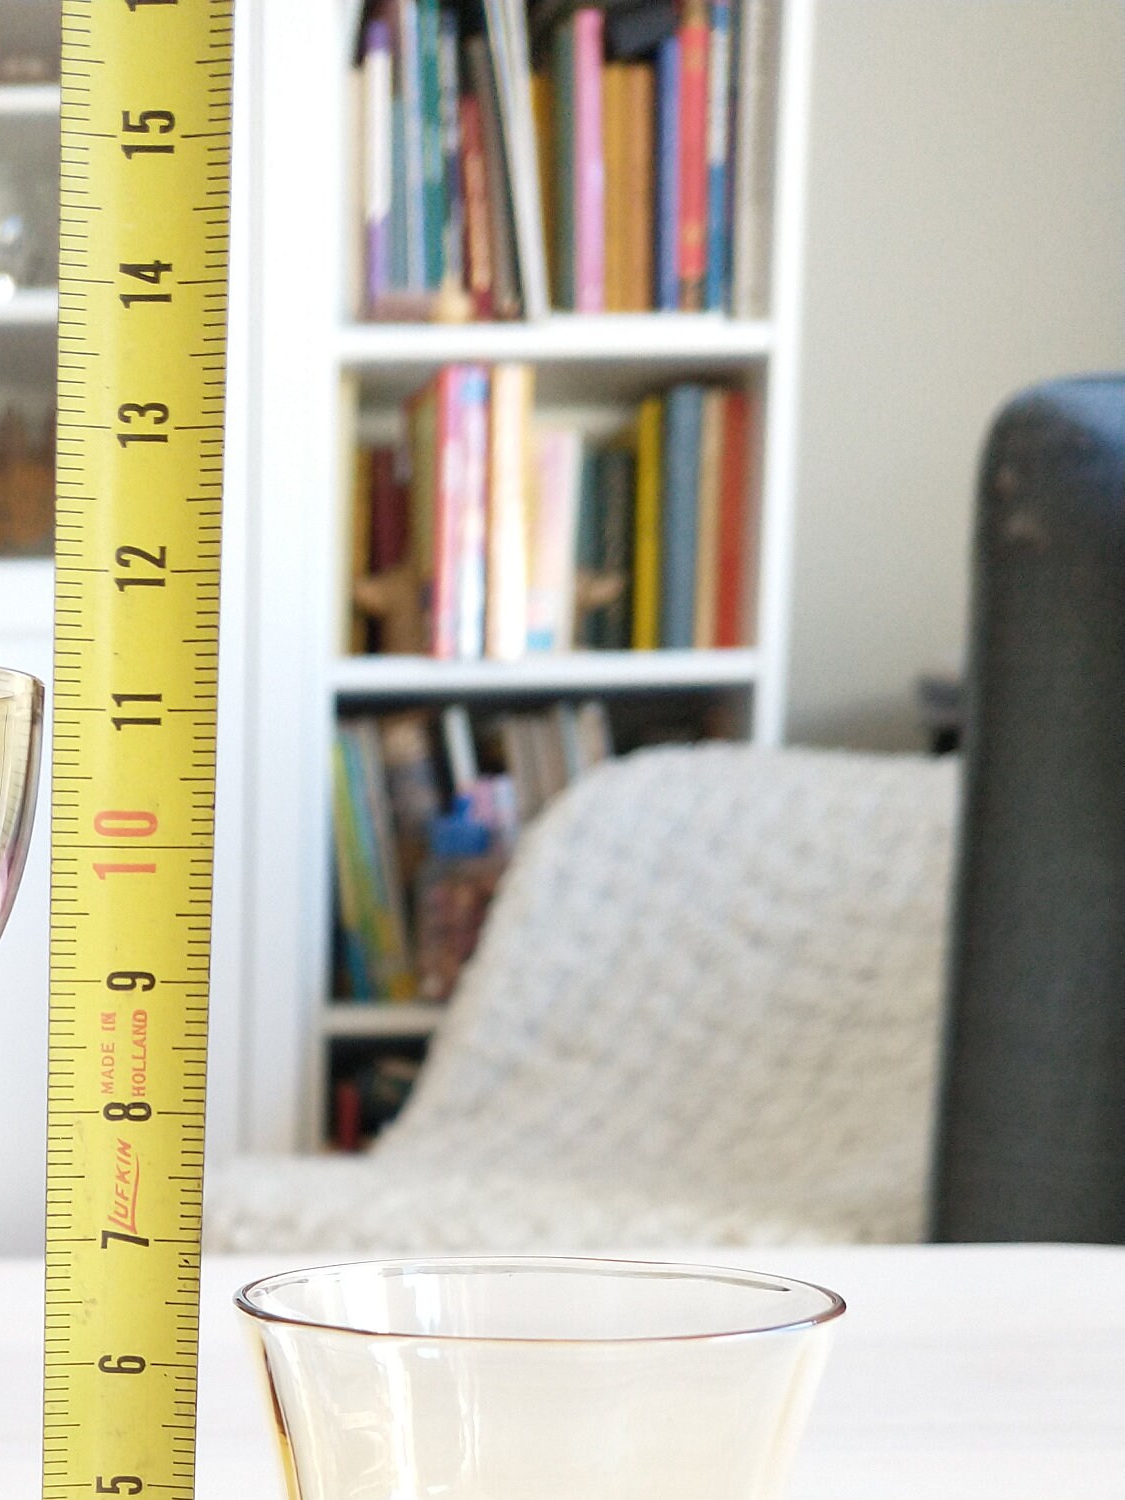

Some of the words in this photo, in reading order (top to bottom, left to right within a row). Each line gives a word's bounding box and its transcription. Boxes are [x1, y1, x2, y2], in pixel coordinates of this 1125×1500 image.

[121, 110, 175, 160] 15
[119, 260, 173, 309] 14
[117, 402, 170, 448] 13
[114, 545, 167, 592] 12
[111, 693, 162, 731] 11
[92, 810, 158, 880] 10
[106, 971, 156, 992] 9
[100, 1011, 117, 1032] IN
[100, 1042, 115, 1095] MADE
[131, 1009, 148, 1097] HOLLAND
[103, 1102, 152, 1121] 8
[107, 1138, 140, 1235] LUFKIN
[101, 1230, 150, 1249] 7
[98, 1354, 146, 1374] 6
[95, 1475, 143, 1495] 5
